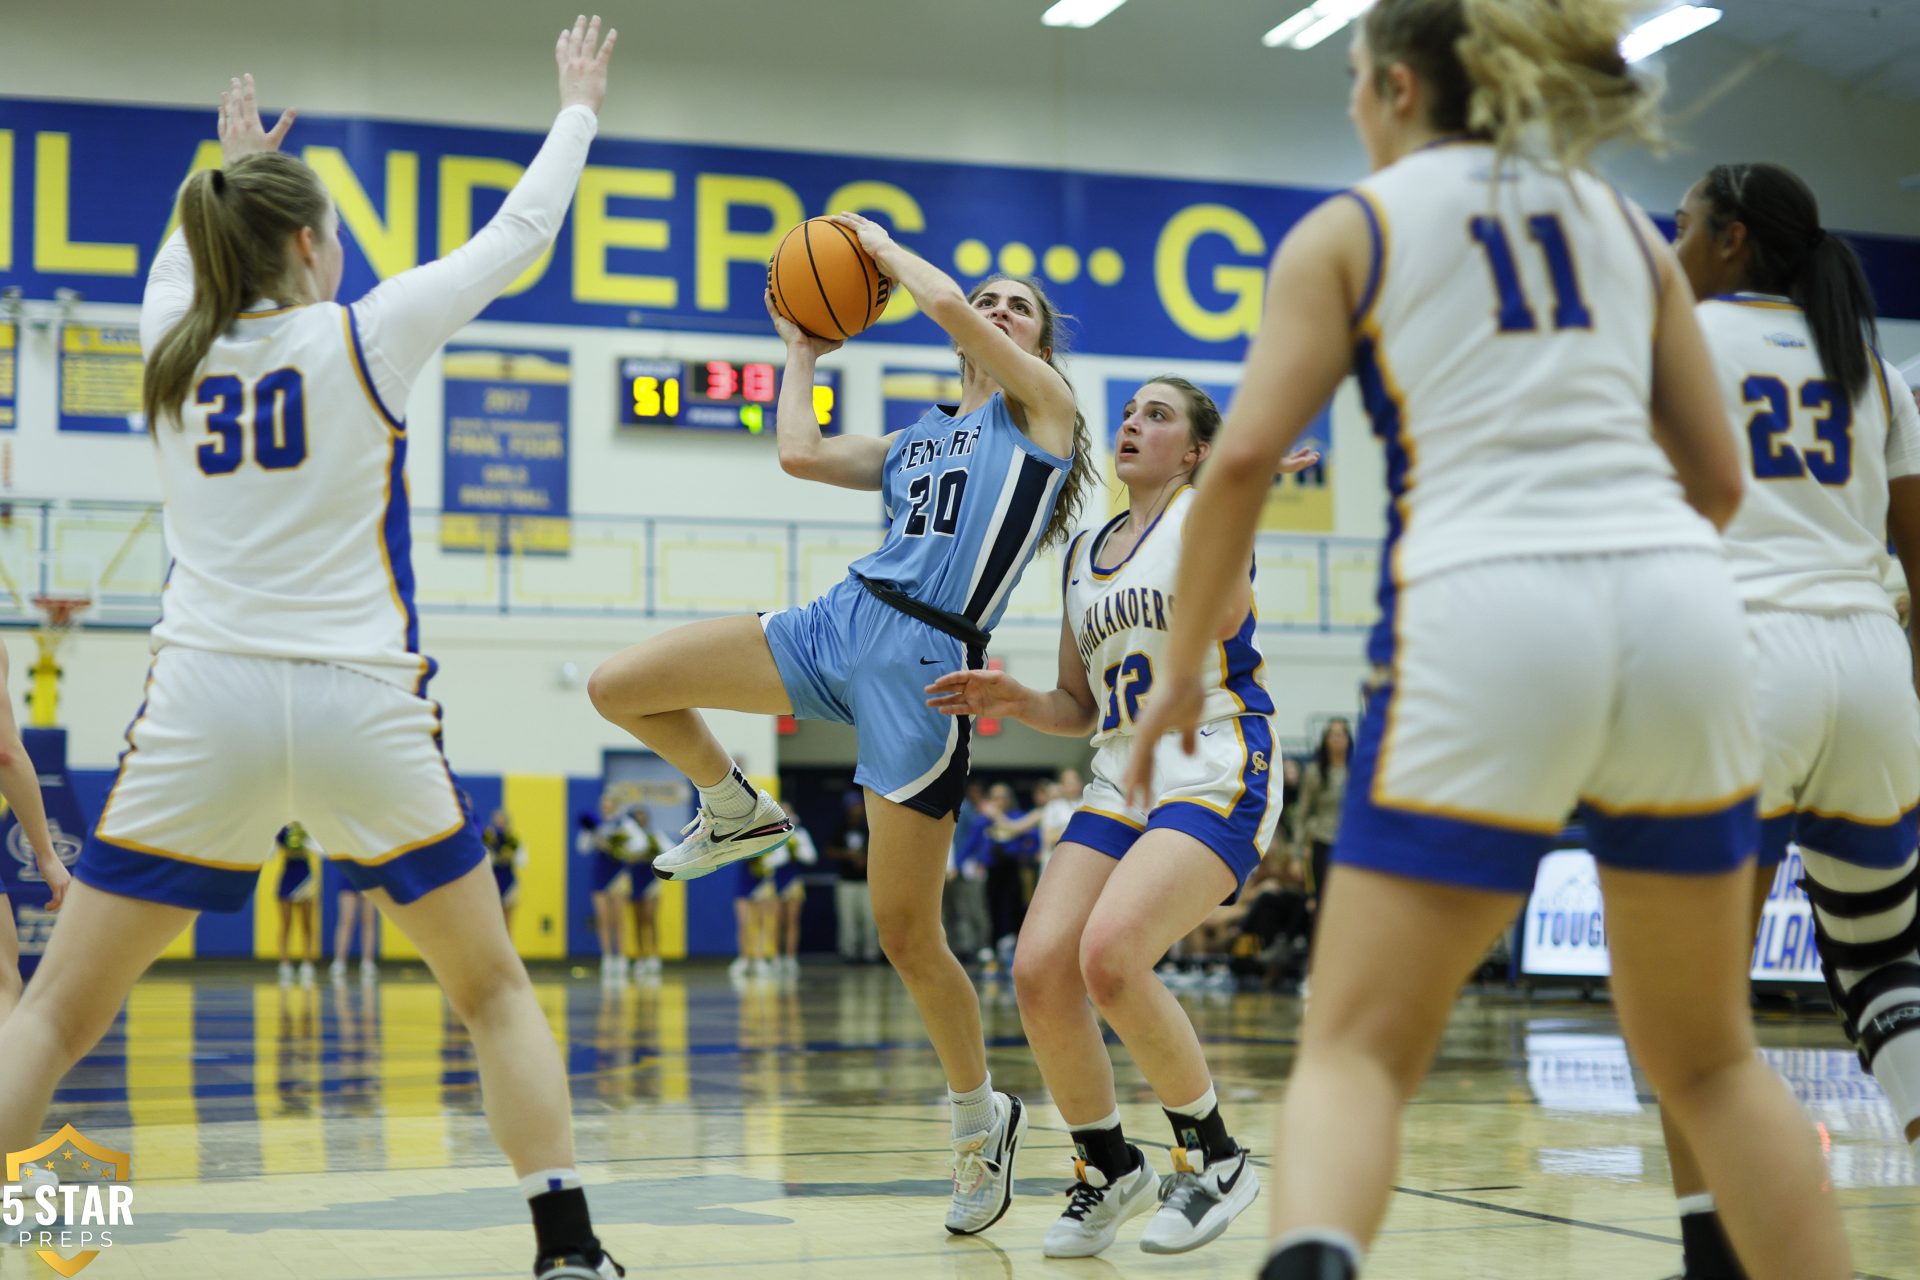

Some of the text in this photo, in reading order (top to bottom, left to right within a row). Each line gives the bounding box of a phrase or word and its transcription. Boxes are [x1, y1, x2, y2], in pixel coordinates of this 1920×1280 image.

[0, 128, 926, 326] LNDERS
[1467, 212, 1596, 334] 11
[193, 365, 309, 477] 30
[633, 376, 679, 417] 51
[1741, 373, 1855, 487] 23
[903, 467, 969, 538] 20
[1537, 910, 1607, 948] TOUG
